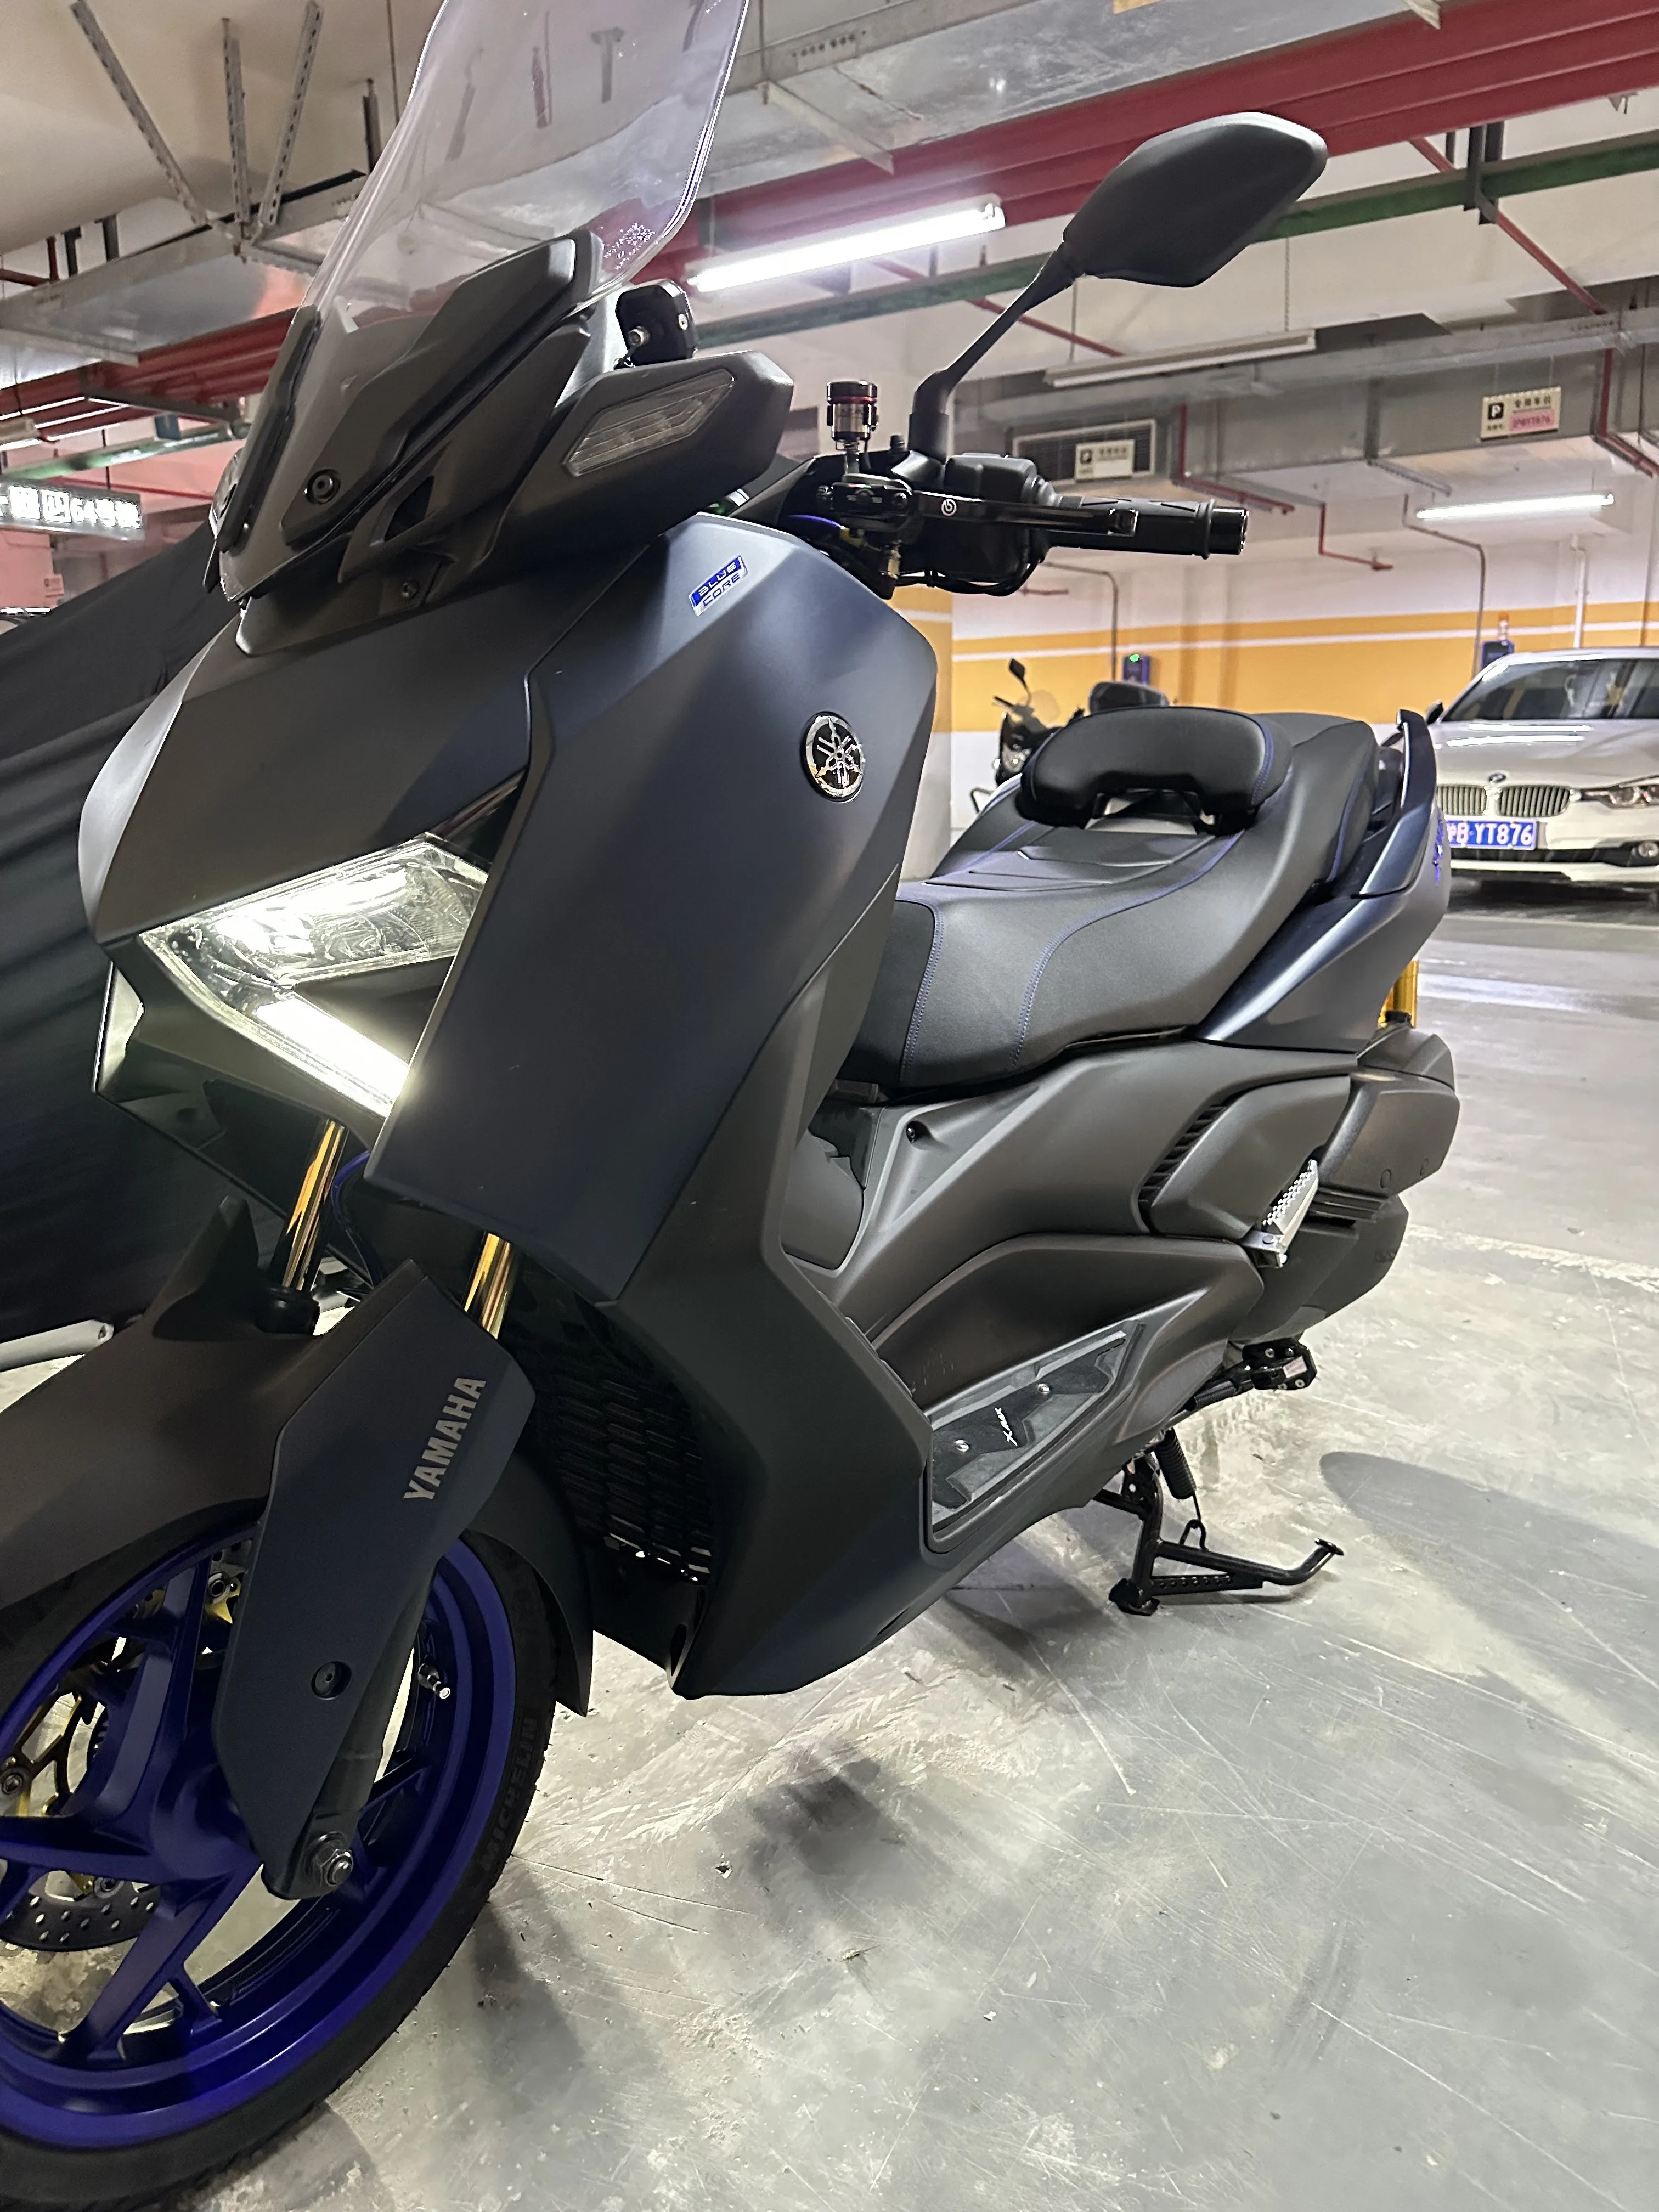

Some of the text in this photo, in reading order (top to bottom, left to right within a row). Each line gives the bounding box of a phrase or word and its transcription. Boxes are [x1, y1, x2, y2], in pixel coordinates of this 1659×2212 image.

[698, 562, 737, 596] BLUE
[703, 572, 741, 606] CORE
[403, 1378, 487, 1499] YAMAHA
